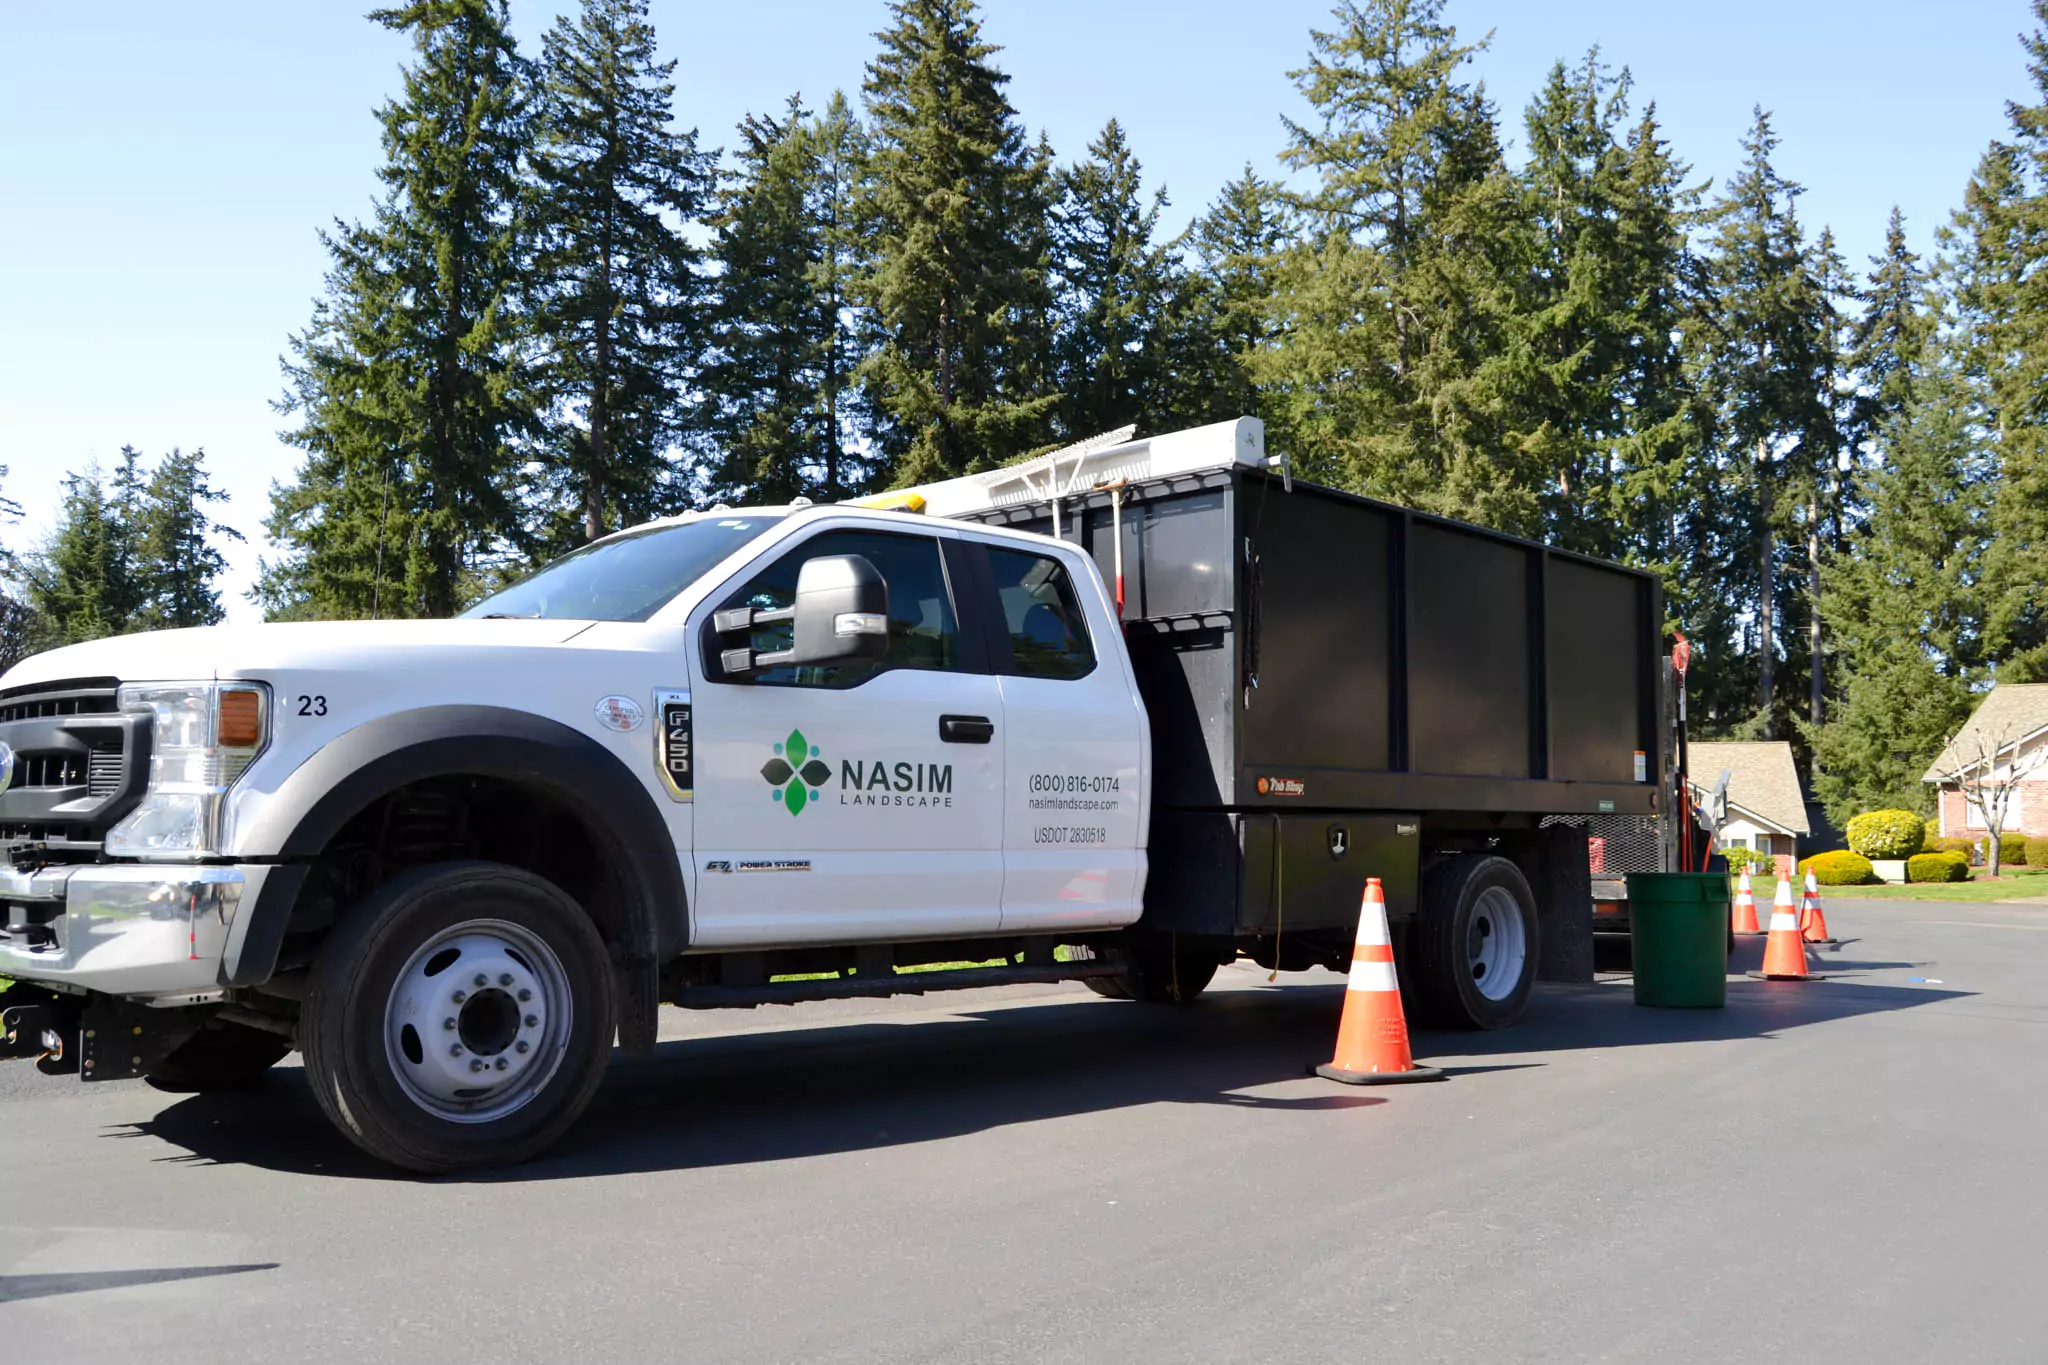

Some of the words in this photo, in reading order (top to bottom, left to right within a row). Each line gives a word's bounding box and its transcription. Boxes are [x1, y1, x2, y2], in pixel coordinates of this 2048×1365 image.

[298, 695, 328, 716] 23
[841, 759, 953, 794] NASIM
[1029, 774, 1065, 794] (800)
[1067, 775, 1119, 793] 816-0174
[840, 794, 953, 808] LANDSCAPE
[1029, 797, 1119, 811] nasimlandscape.com
[1034, 826, 1067, 843] USDOT
[1069, 827, 1106, 843] 2830518
